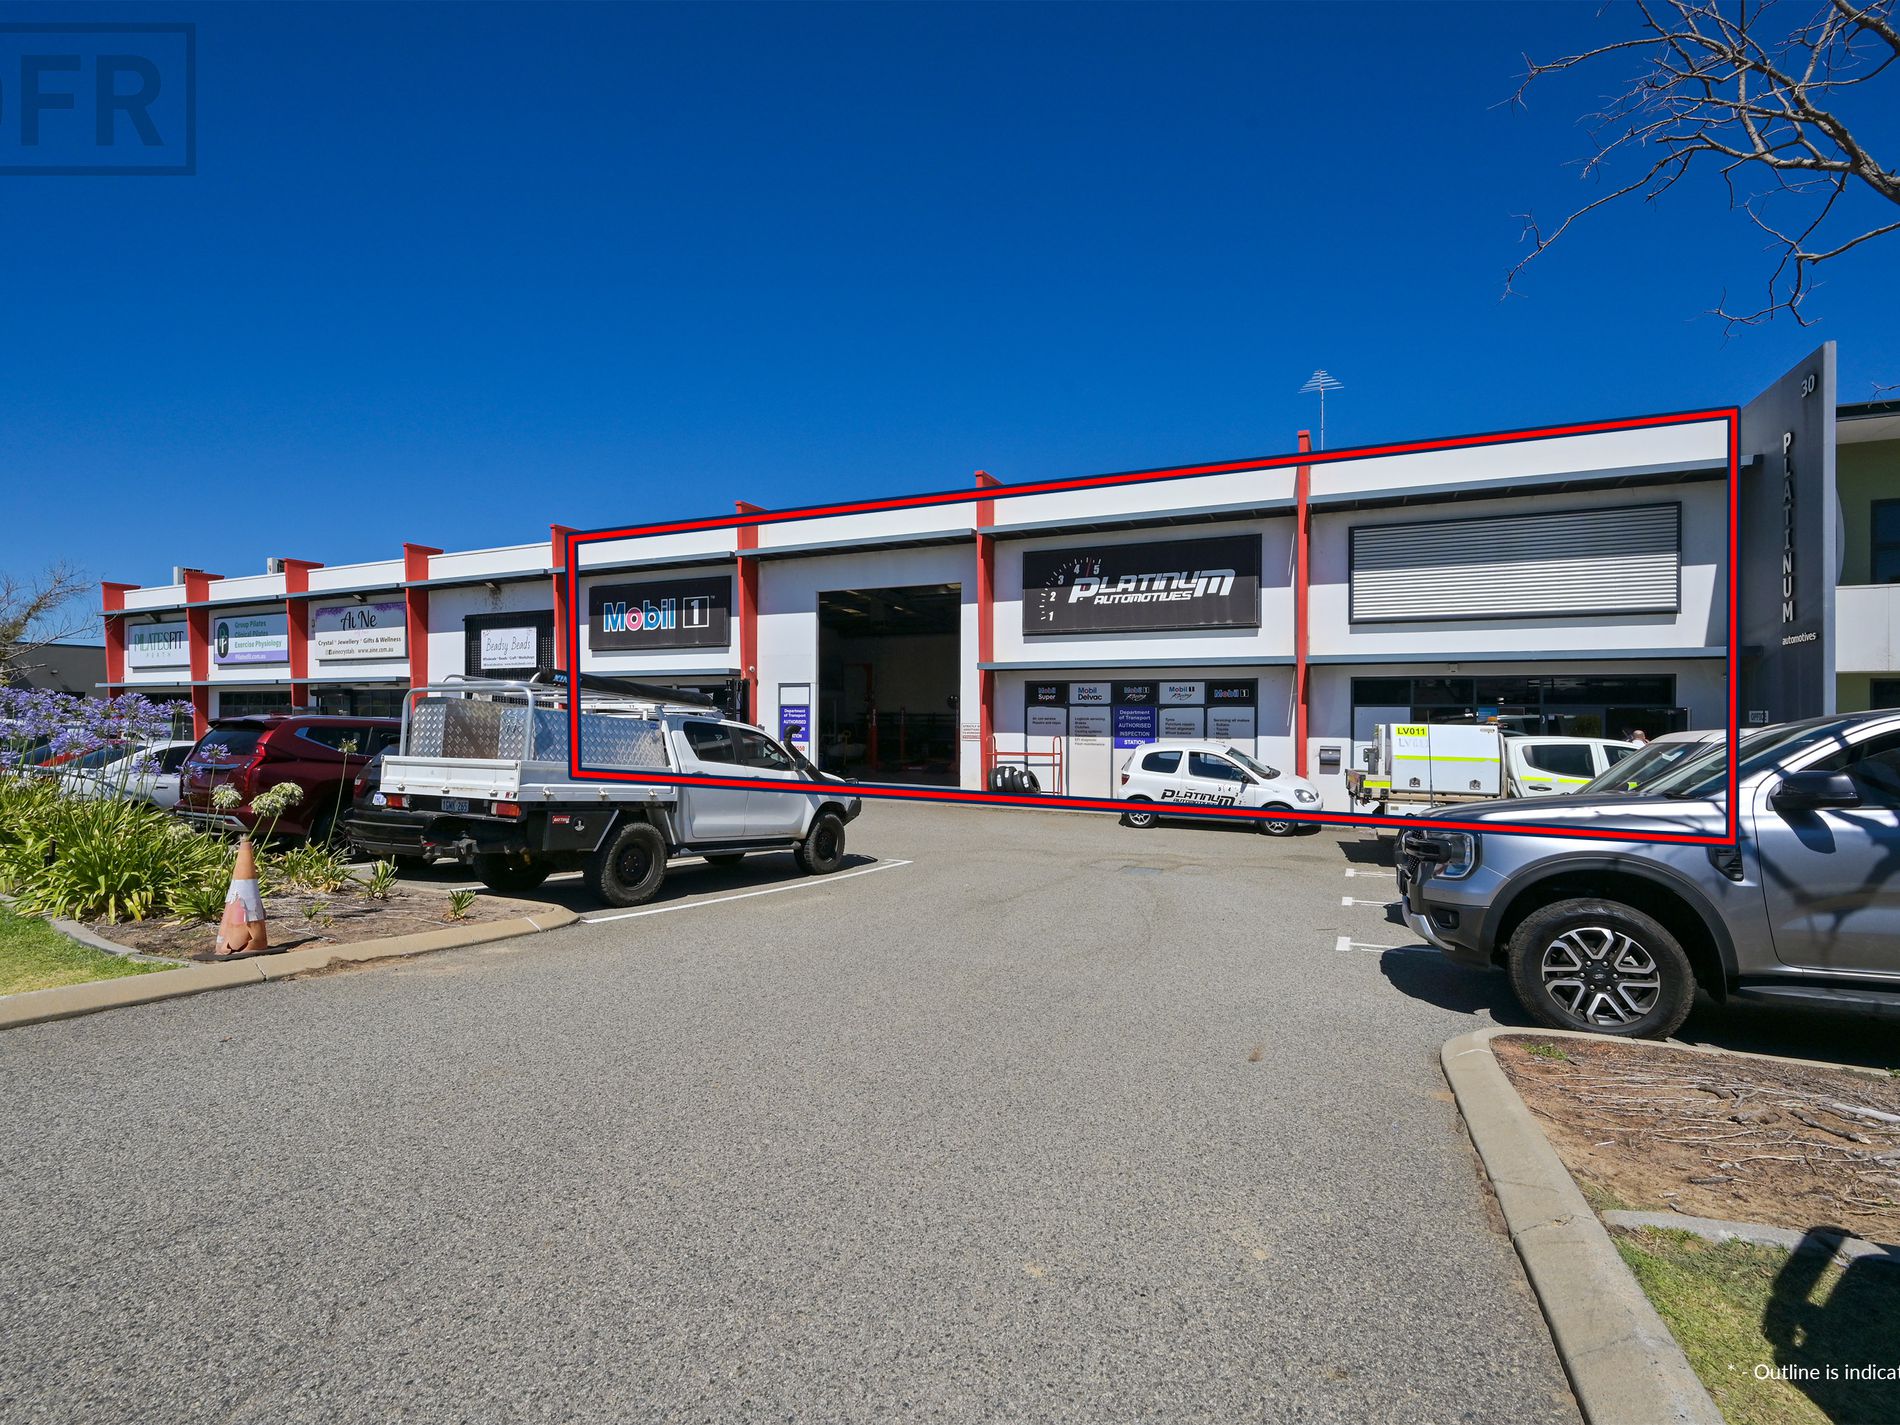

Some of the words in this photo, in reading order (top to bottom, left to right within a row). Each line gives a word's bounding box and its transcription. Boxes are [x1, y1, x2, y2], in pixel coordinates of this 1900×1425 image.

[1800, 374, 1816, 398] 30
[1782, 431, 1795, 624] PLATINUM
[1073, 564, 1080, 574] 4
[1093, 564, 1100, 575] 5
[1057, 574, 1065, 585] 3
[1068, 568, 1236, 604] PLATINUM
[1049, 591, 1057, 602] 2
[1093, 590, 1193, 605] AUTOMOTIVES
[357, 609, 378, 628] Ne
[603, 597, 676, 633] Mobil
[690, 599, 700, 625] 1
[1048, 611, 1054, 621] 1
[1781, 631, 1817, 647] automotives
[1077, 686, 1098, 694] Mobil
[1214, 688, 1240, 698] Mobil
[1077, 693, 1103, 701] Delvac
[1397, 727, 1425, 735] LV011
[1160, 788, 1236, 807] PLATINUM
